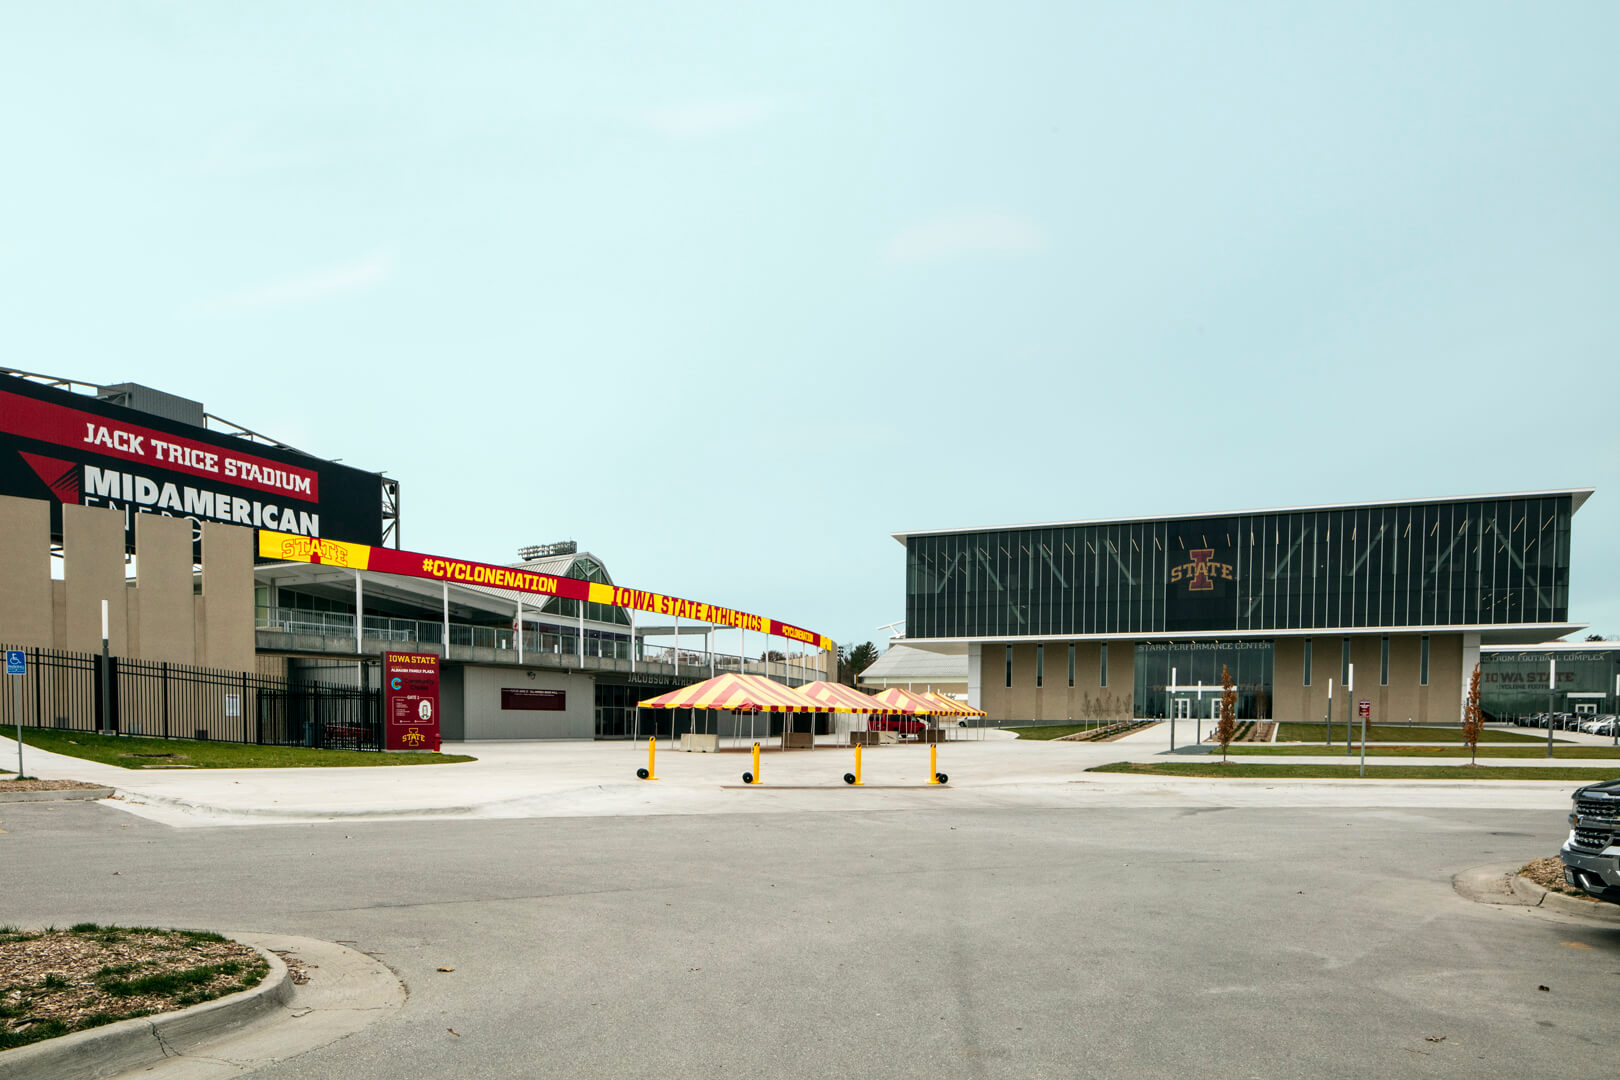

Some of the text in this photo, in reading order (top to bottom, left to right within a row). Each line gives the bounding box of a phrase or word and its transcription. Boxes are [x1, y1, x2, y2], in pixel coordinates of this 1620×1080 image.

[84, 422, 311, 495] JACK TRICE STADIUM
[84, 465, 319, 538] MIDAMERICAN
[281, 538, 348, 568] STATE
[423, 558, 557, 594] #CYCLONENATION
[1170, 562, 1233, 583] STATE
[611, 587, 762, 631] IOWA STATE ATHLETICS
[1138, 642, 1271, 652] STARK PERFORMANCE CENTER
[389, 654, 436, 665] IOWA STATE
[1563, 654, 1605, 662] COMPLEX
[628, 673, 670, 686] JACOBSON
[1485, 672, 1524, 683] IOWA
[402, 733, 425, 742] STATE
